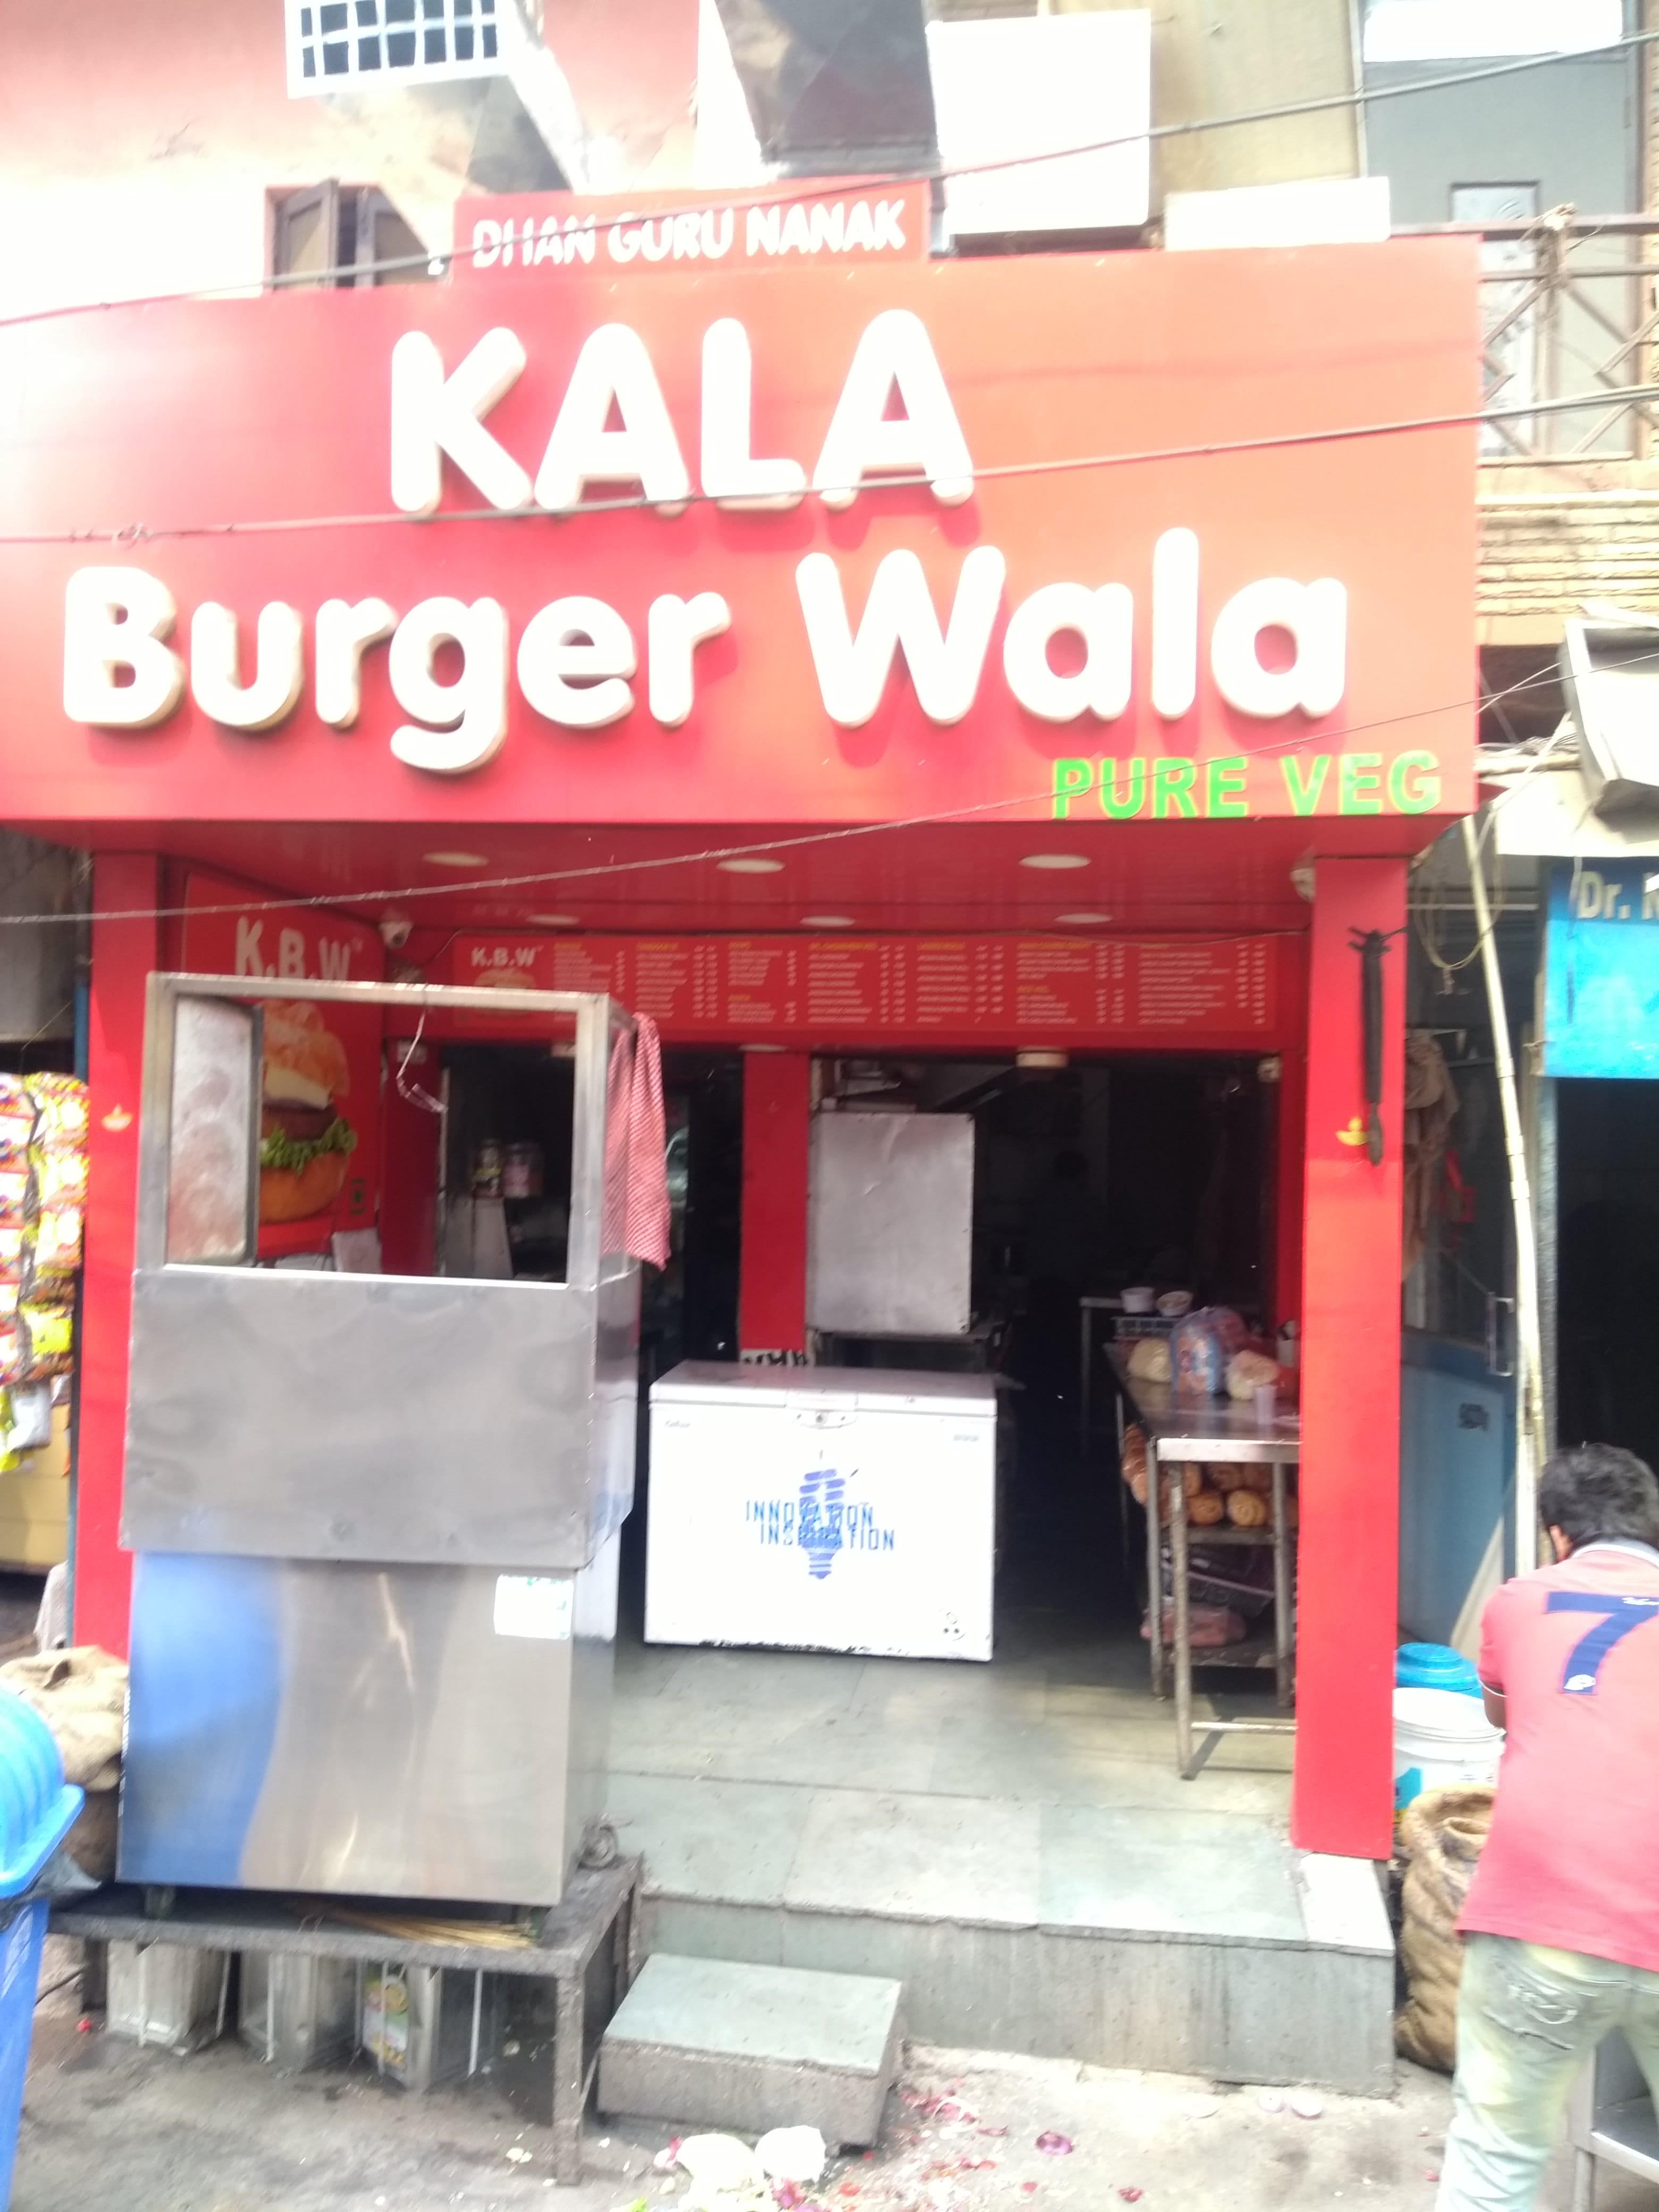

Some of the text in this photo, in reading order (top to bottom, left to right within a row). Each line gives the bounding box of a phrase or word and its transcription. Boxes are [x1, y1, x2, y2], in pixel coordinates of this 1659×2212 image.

[473, 199, 906, 267] DHAN GURU NANAK
[391, 309, 974, 516] KALA
[63, 527, 1348, 774] Burger Wala
[1052, 750, 1442, 820] PURE VEG
[1578, 871, 1631, 919] Dr.
[1545, 1591, 1659, 1695] 7
